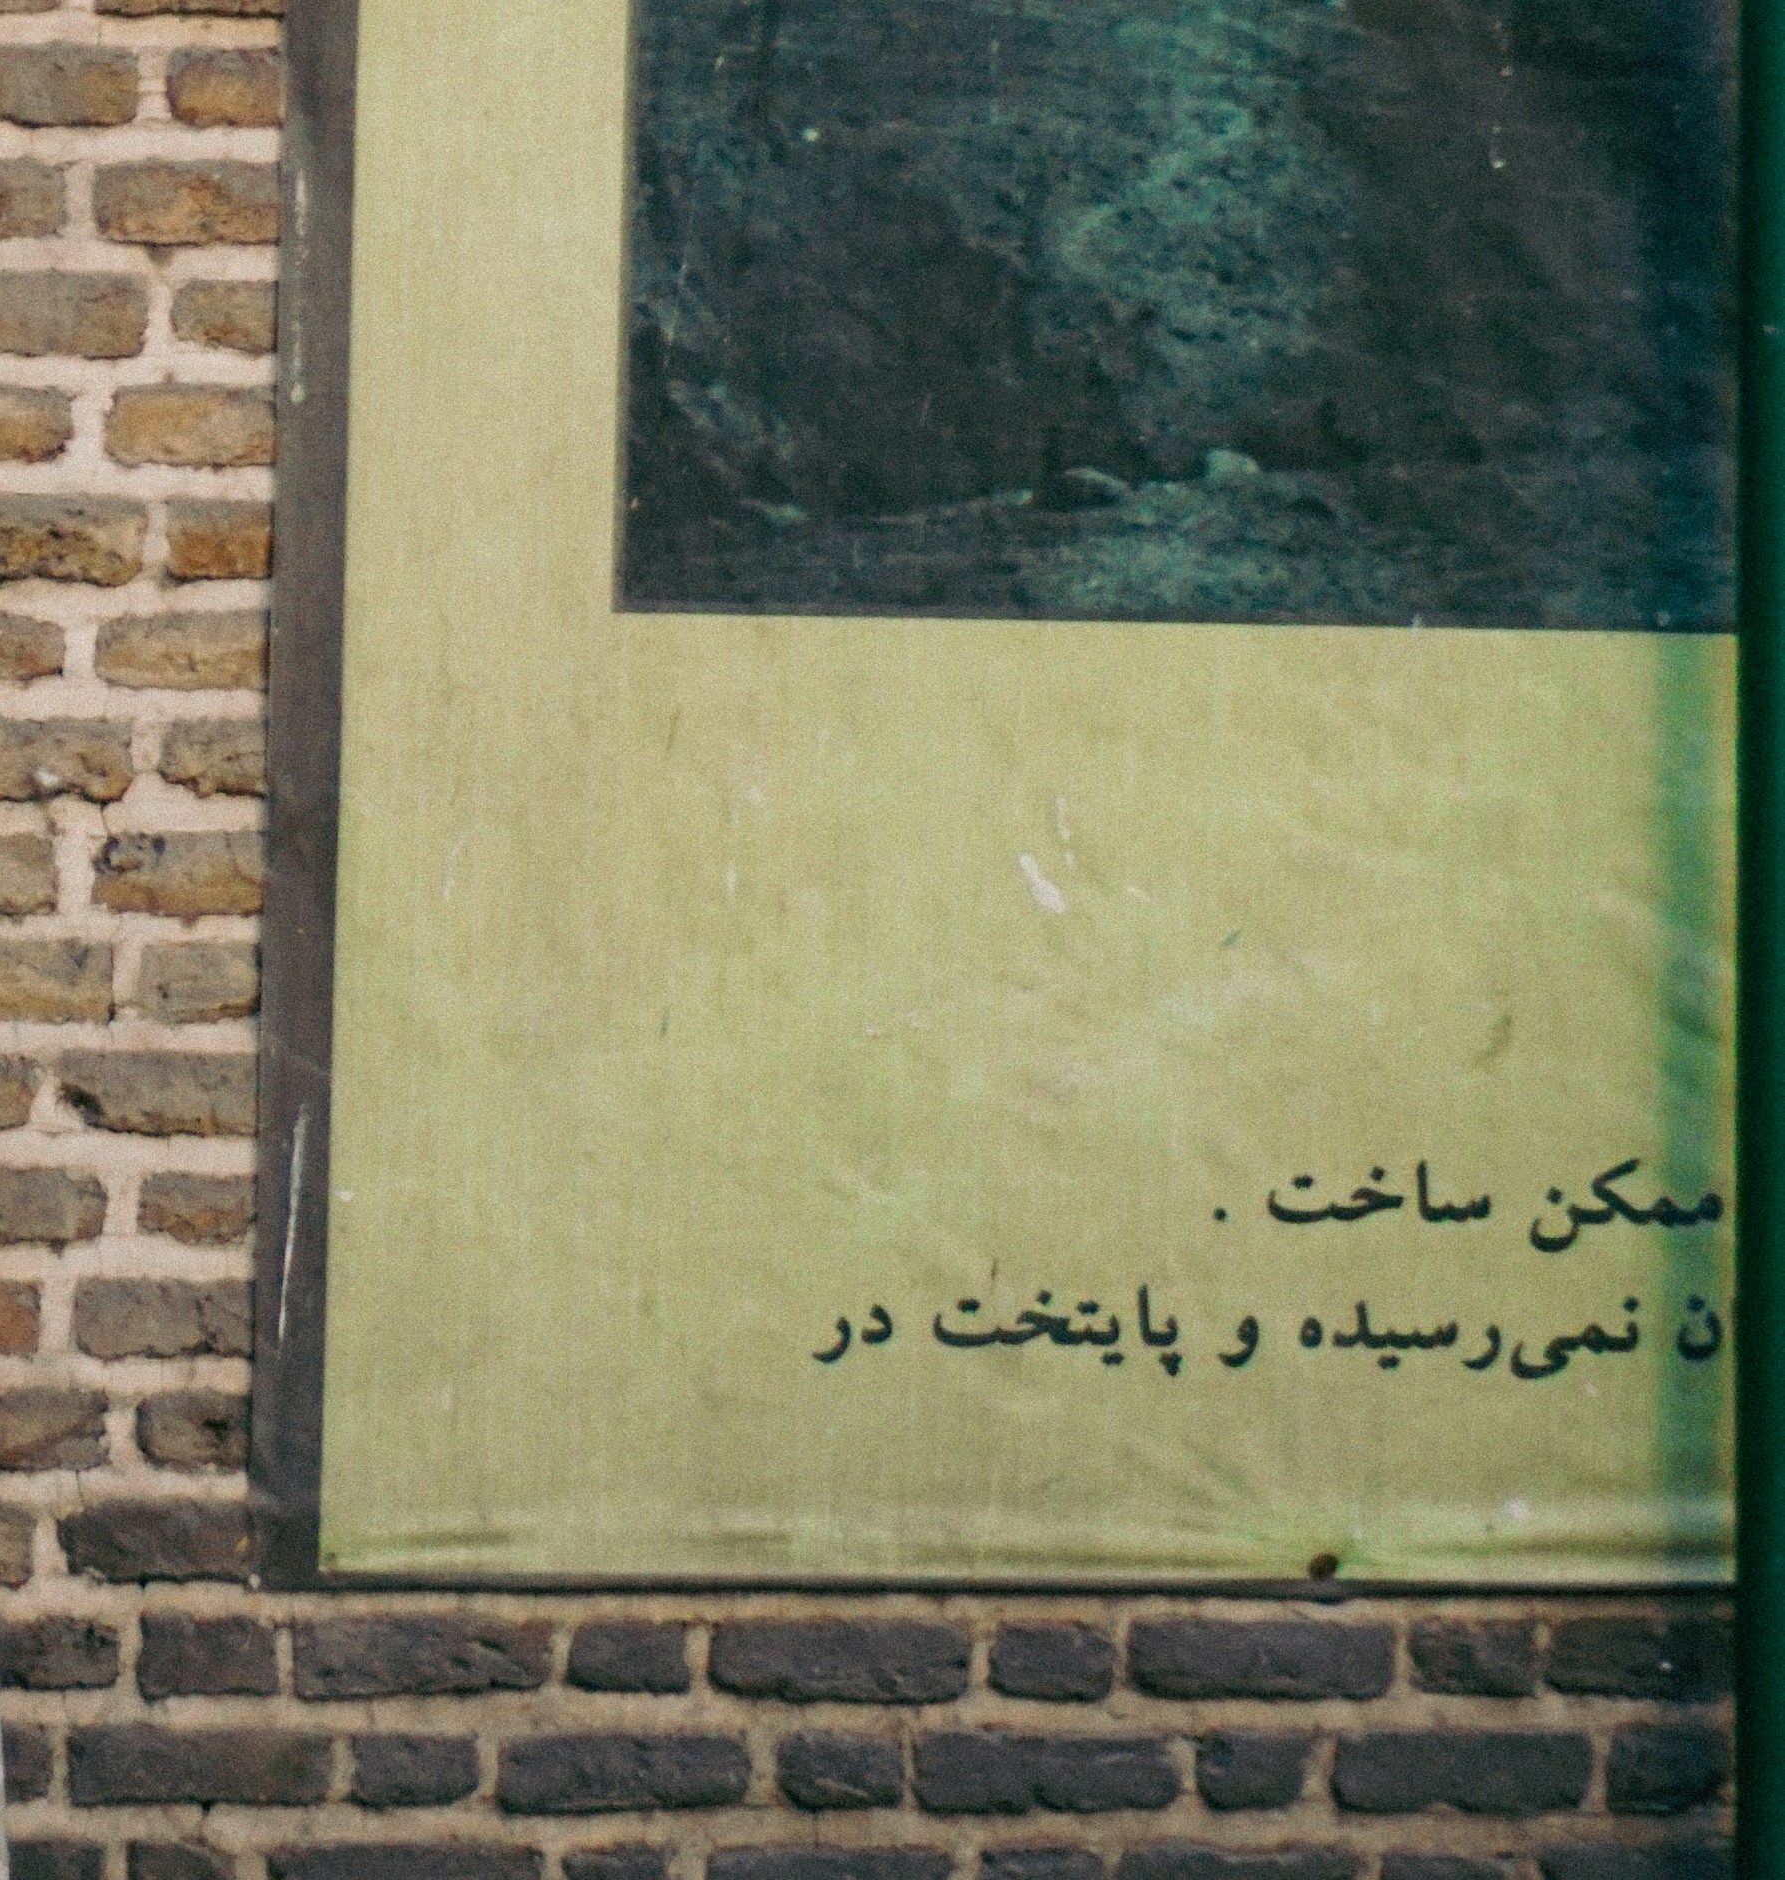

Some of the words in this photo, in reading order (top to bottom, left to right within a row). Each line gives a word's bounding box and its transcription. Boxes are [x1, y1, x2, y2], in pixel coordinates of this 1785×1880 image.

[1265, 1158, 1494, 1227] ساخت
[1528, 1157, 1724, 1255] ممکن
[811, 1302, 897, 1367] در
[931, 1281, 1184, 1379] پایتخت
[1217, 1313, 1262, 1371] و
